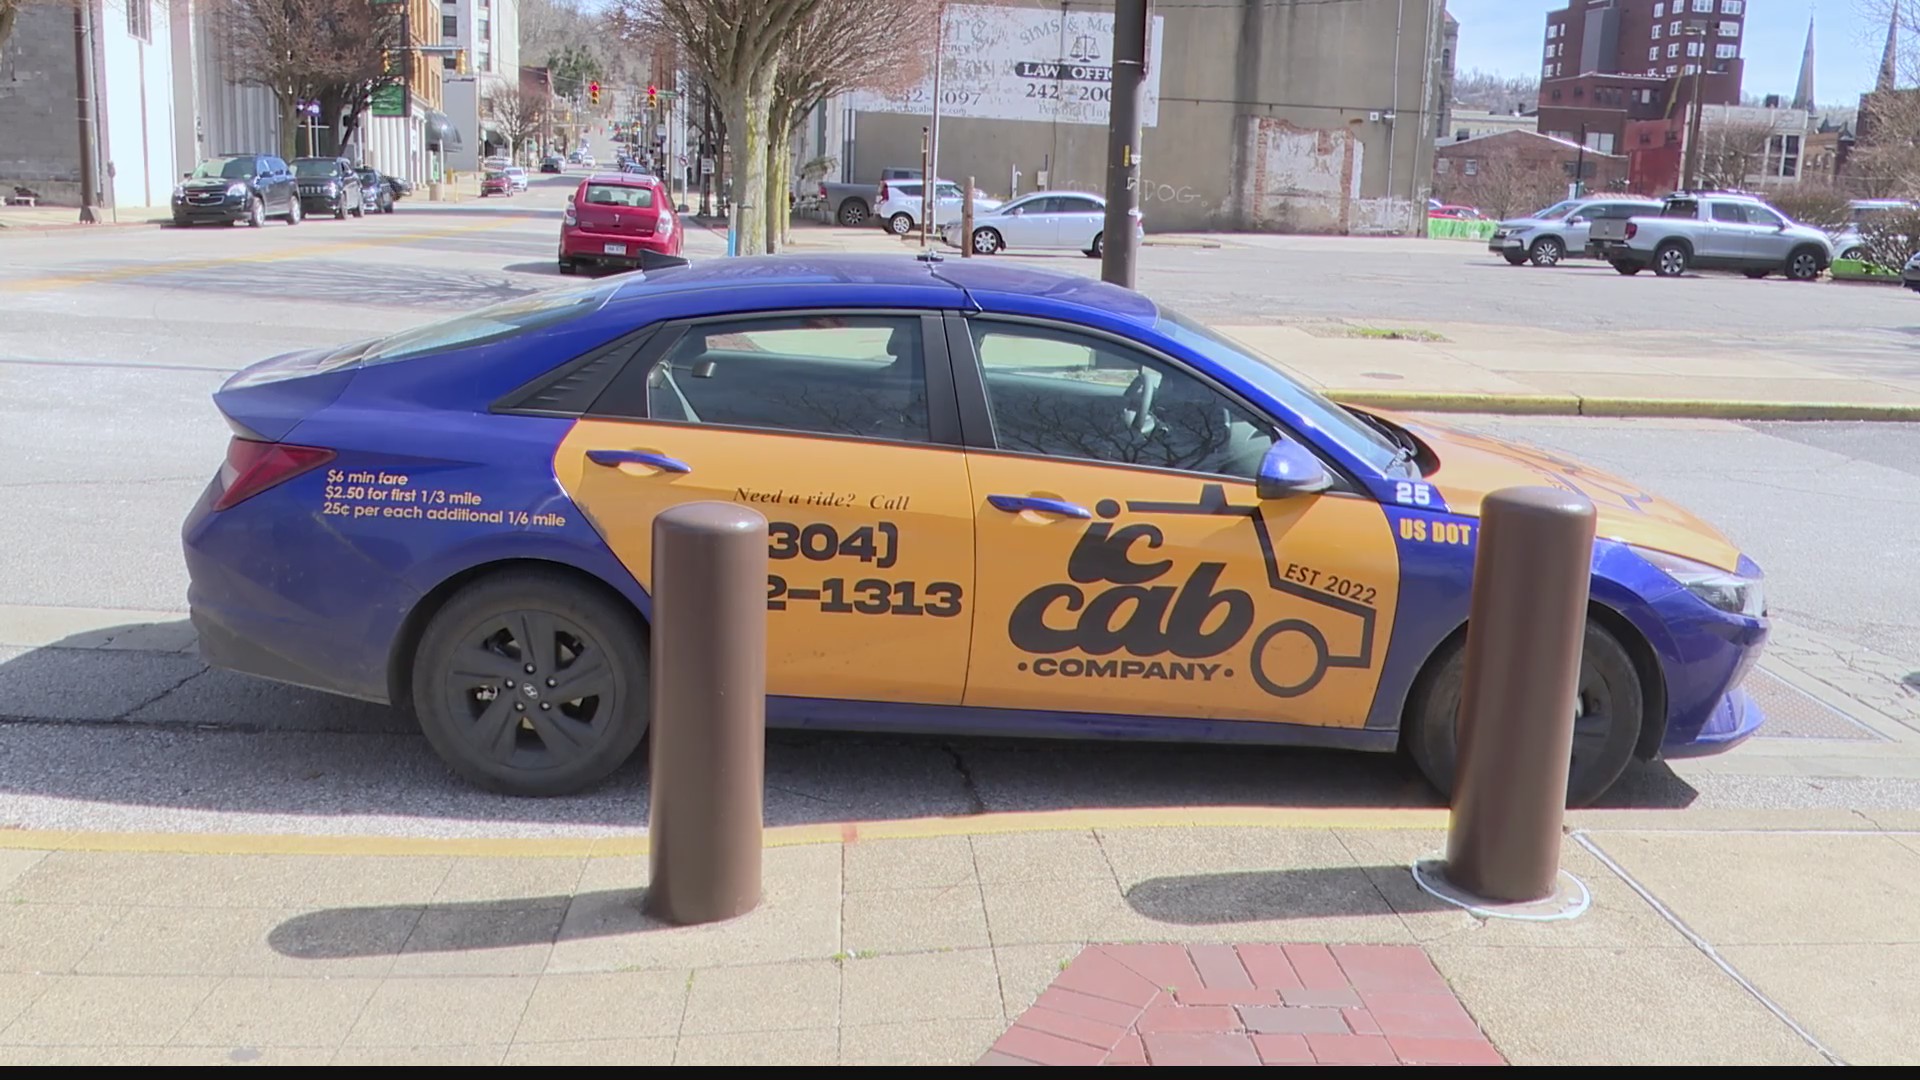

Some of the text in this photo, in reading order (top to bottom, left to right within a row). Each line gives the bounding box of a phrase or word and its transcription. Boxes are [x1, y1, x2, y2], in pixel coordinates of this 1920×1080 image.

[1020, 19, 1060, 46] SIMS
[1067, 17, 1079, 33] &
[1023, 63, 1060, 78] LAW
[1025, 83, 1060, 100] 242
[327, 469, 408, 486] $6 min fare
[325, 485, 482, 506] $2.50 for first 1/3 mile
[733, 487, 909, 511] Need a ride? Call
[1396, 482, 1430, 505] 25
[323, 502, 565, 527] 25¢ per each additional 1/6 mile
[1067, 498, 1173, 585] ic
[1400, 518, 1471, 545] US DOT
[768, 521, 898, 569] 304)
[767, 574, 963, 618] 2-1313
[1284, 562, 1378, 606] EST 2022
[1008, 561, 1255, 659] cab
[1032, 657, 1222, 681] COMPANY
